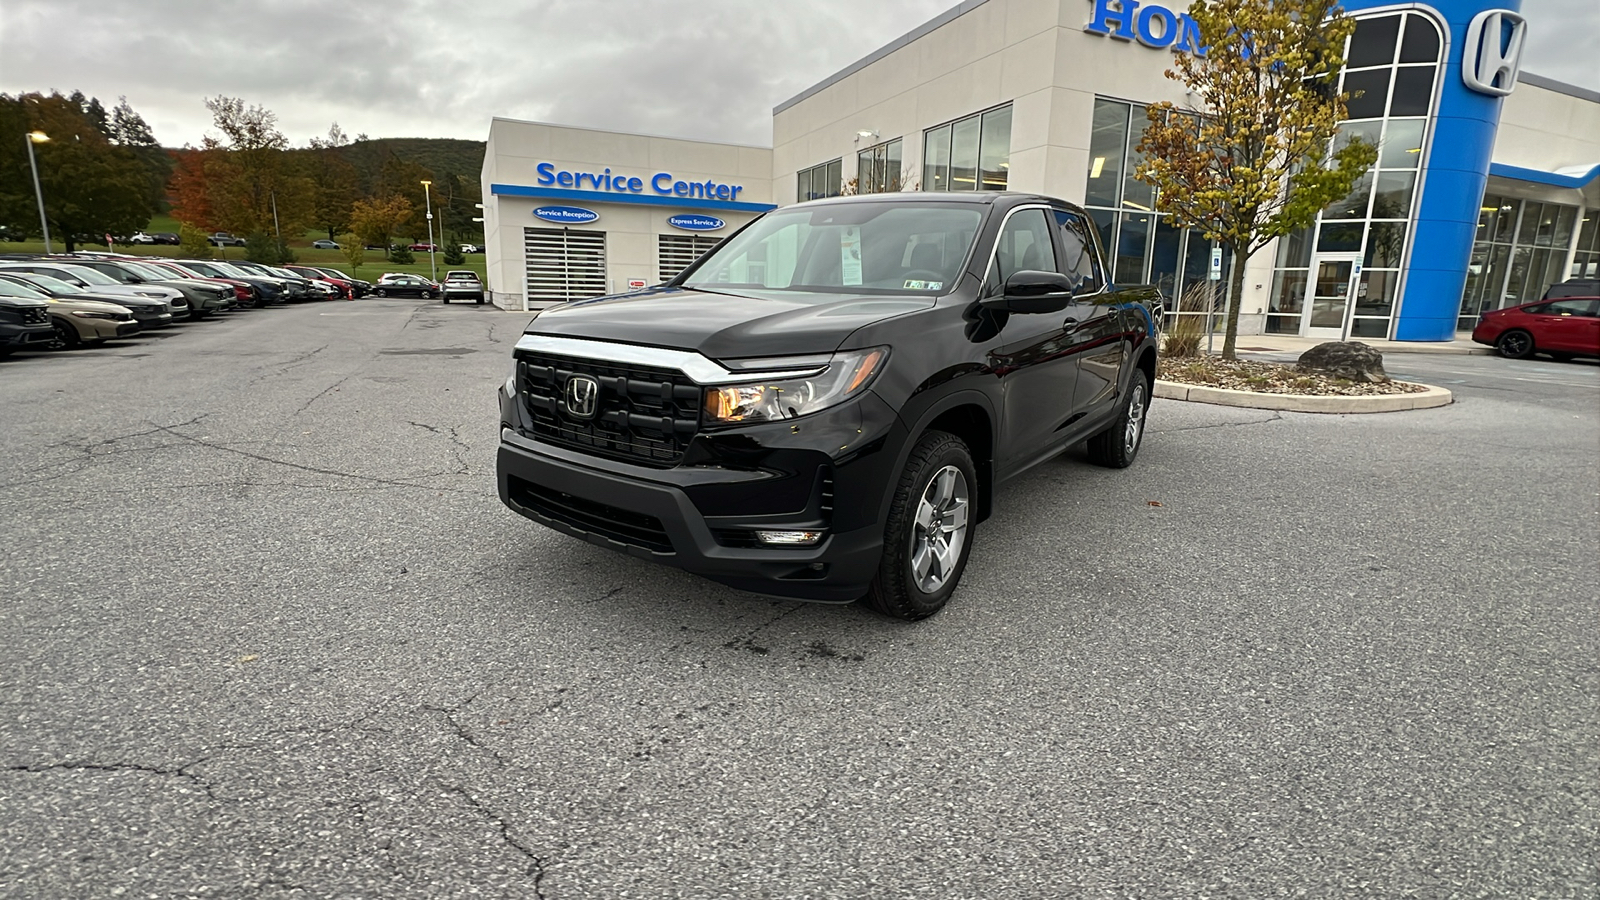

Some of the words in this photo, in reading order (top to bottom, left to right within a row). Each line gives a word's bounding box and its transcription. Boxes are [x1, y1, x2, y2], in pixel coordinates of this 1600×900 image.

[1084, 0, 1255, 62] HON
[536, 162, 643, 193] Service
[651, 173, 743, 200] Center
[536, 209, 561, 217] Service
[562, 210, 595, 219] Reception
[670, 217, 692, 225] Express
[693, 218, 714, 226] Service
